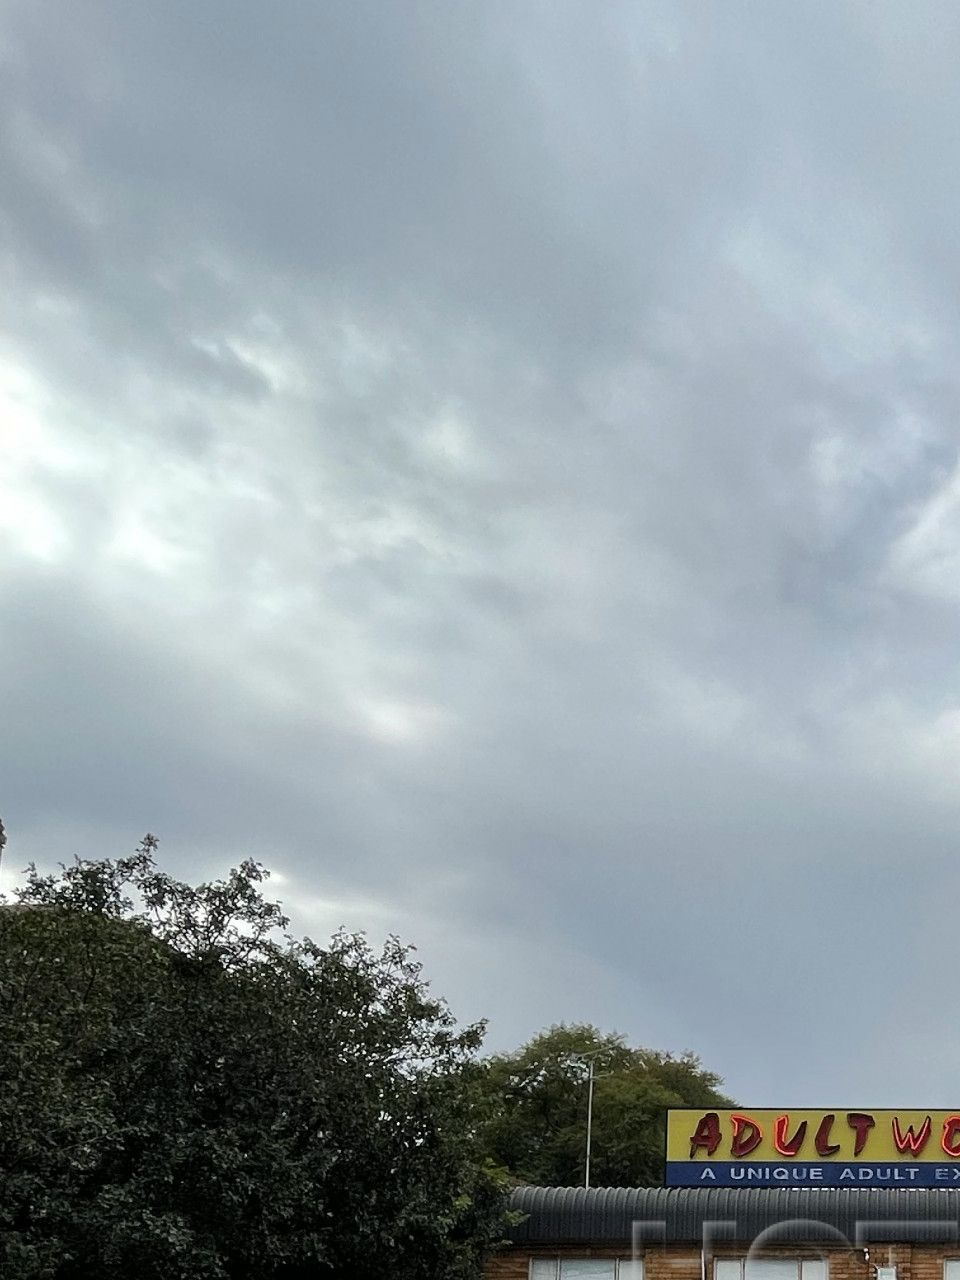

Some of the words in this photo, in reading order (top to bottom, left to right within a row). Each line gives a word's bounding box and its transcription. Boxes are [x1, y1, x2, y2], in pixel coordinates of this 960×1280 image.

[690, 1112, 876, 1158] ADULT
[700, 1167, 717, 1180] A
[730, 1167, 824, 1180] UNIQUE
[839, 1167, 920, 1180] ADULT
